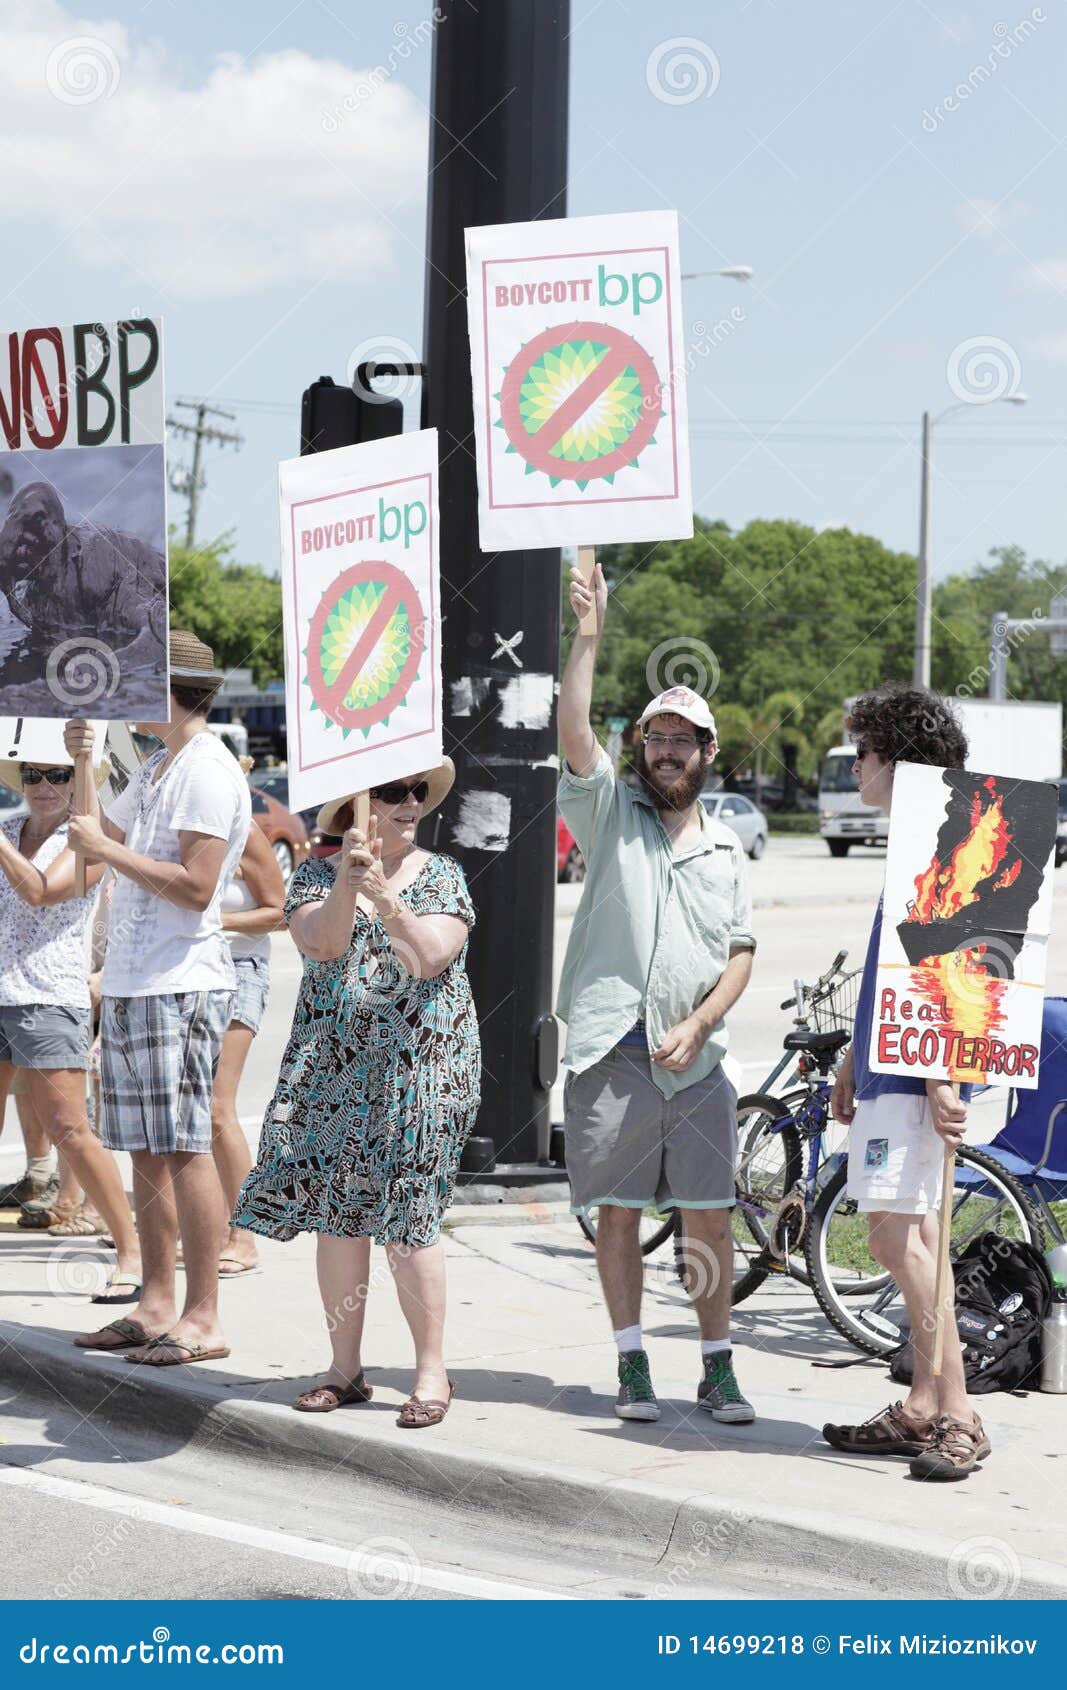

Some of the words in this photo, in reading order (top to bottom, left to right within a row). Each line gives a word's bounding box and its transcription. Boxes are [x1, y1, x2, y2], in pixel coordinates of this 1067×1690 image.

[495, 279, 592, 307] BOYCOTT
[598, 264, 663, 315] bp
[73, 318, 159, 446] BP
[301, 514, 375, 555] BOYCOTT
[379, 497, 427, 549] bp
[879, 988, 952, 1022] Real
